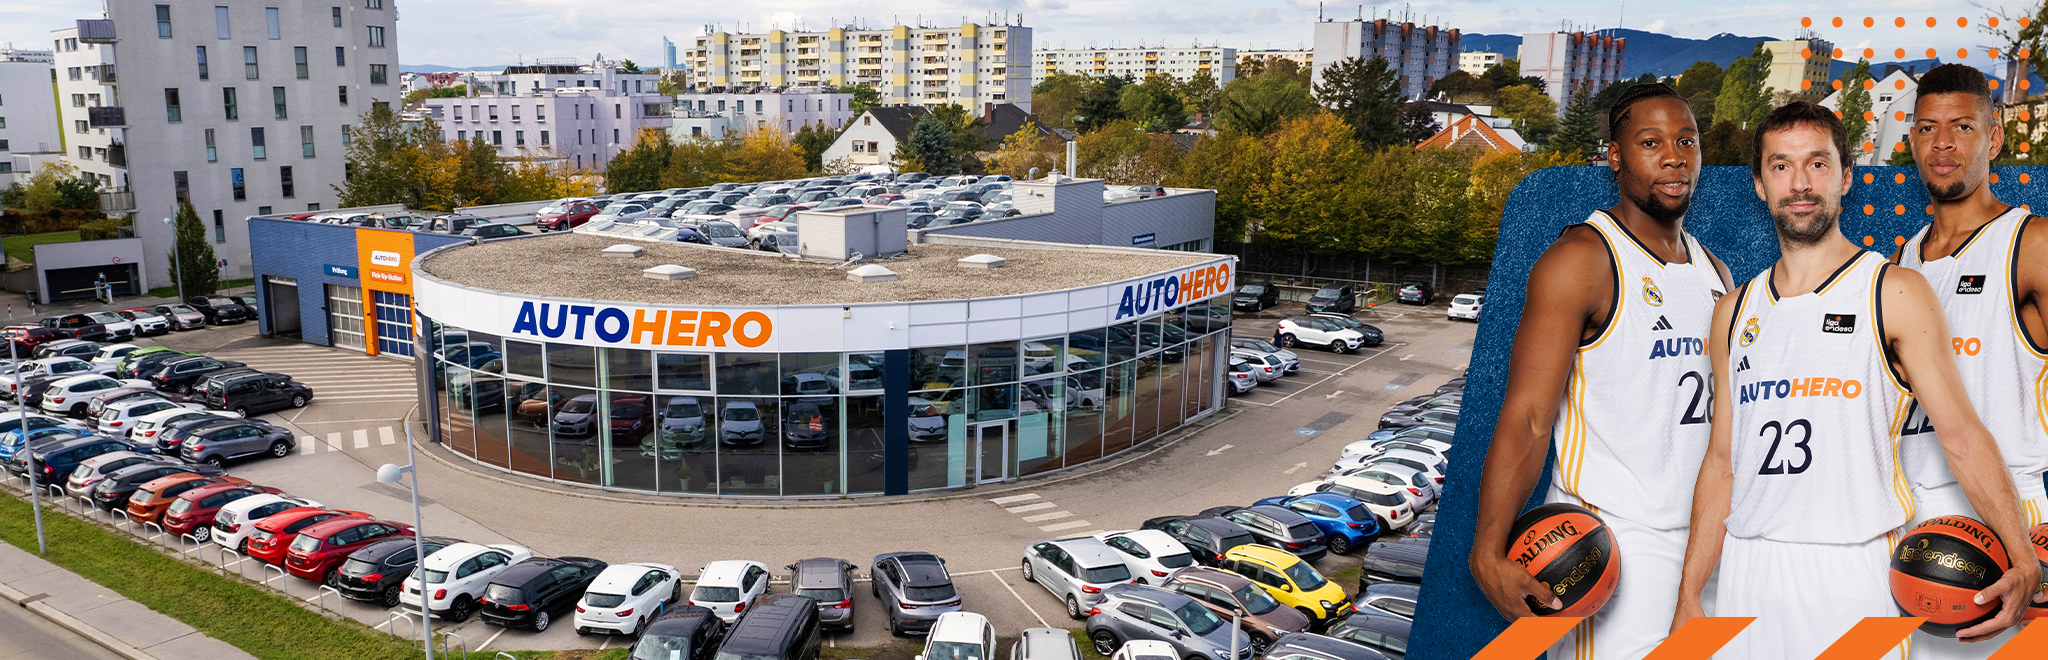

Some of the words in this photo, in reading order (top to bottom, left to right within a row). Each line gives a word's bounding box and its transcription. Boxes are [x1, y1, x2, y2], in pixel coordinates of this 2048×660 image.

[371, 271, 403, 282] Pick-Up-Station
[375, 254, 398, 262] AUTOHERO
[1115, 263, 1230, 321] AUTOHERO
[512, 301, 773, 348] AUTOHERO
[1649, 337, 1710, 360] AUTO
[1740, 377, 1862, 404] AUTOHERO
[1758, 418, 1813, 475] 23
[1516, 520, 1578, 568] PALDING
[1553, 546, 1603, 596] endesa
[1922, 549, 1987, 580] endesa
